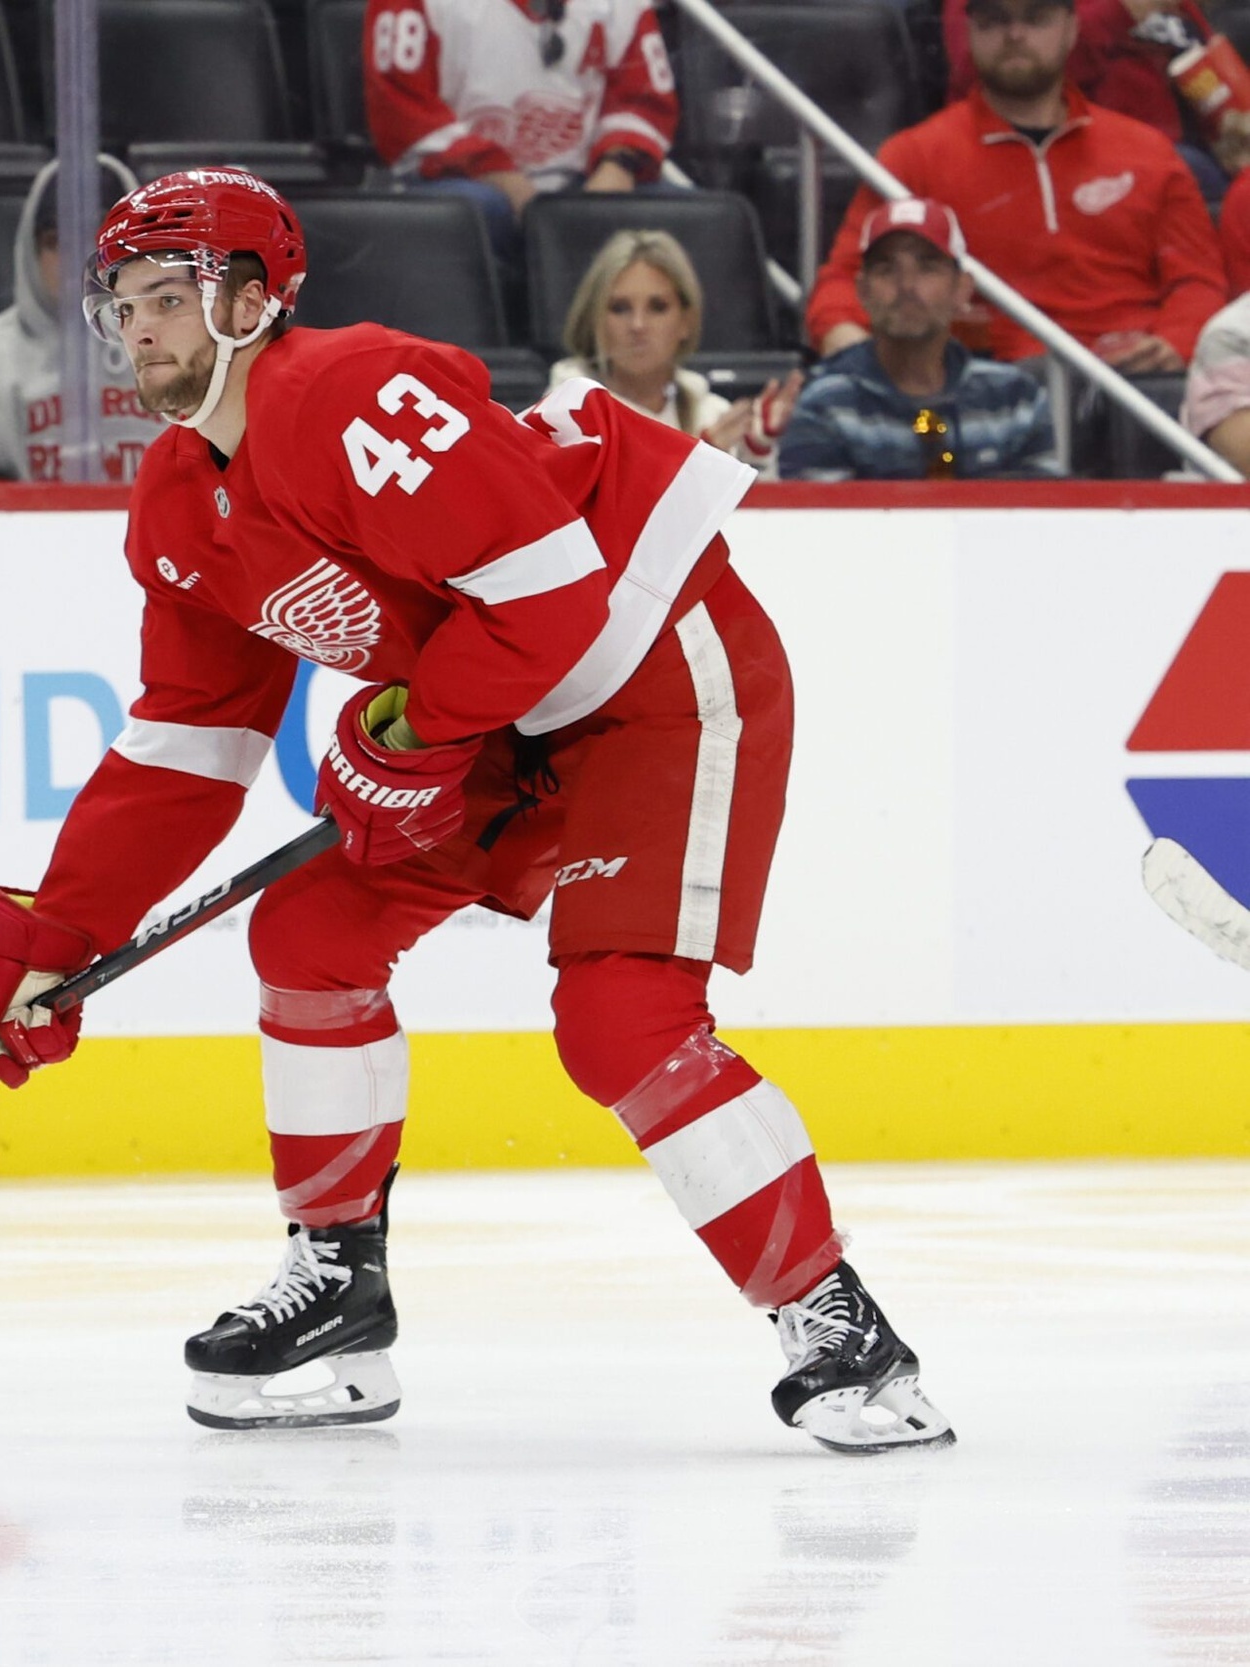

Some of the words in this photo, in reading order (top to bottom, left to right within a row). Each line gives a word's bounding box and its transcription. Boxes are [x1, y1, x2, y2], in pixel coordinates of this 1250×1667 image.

[373, 10, 428, 73] 88
[99, 219, 129, 245] CCM
[341, 372, 471, 498] 43
[327, 732, 442, 808] ARRIOR
[555, 856, 629, 887] CM
